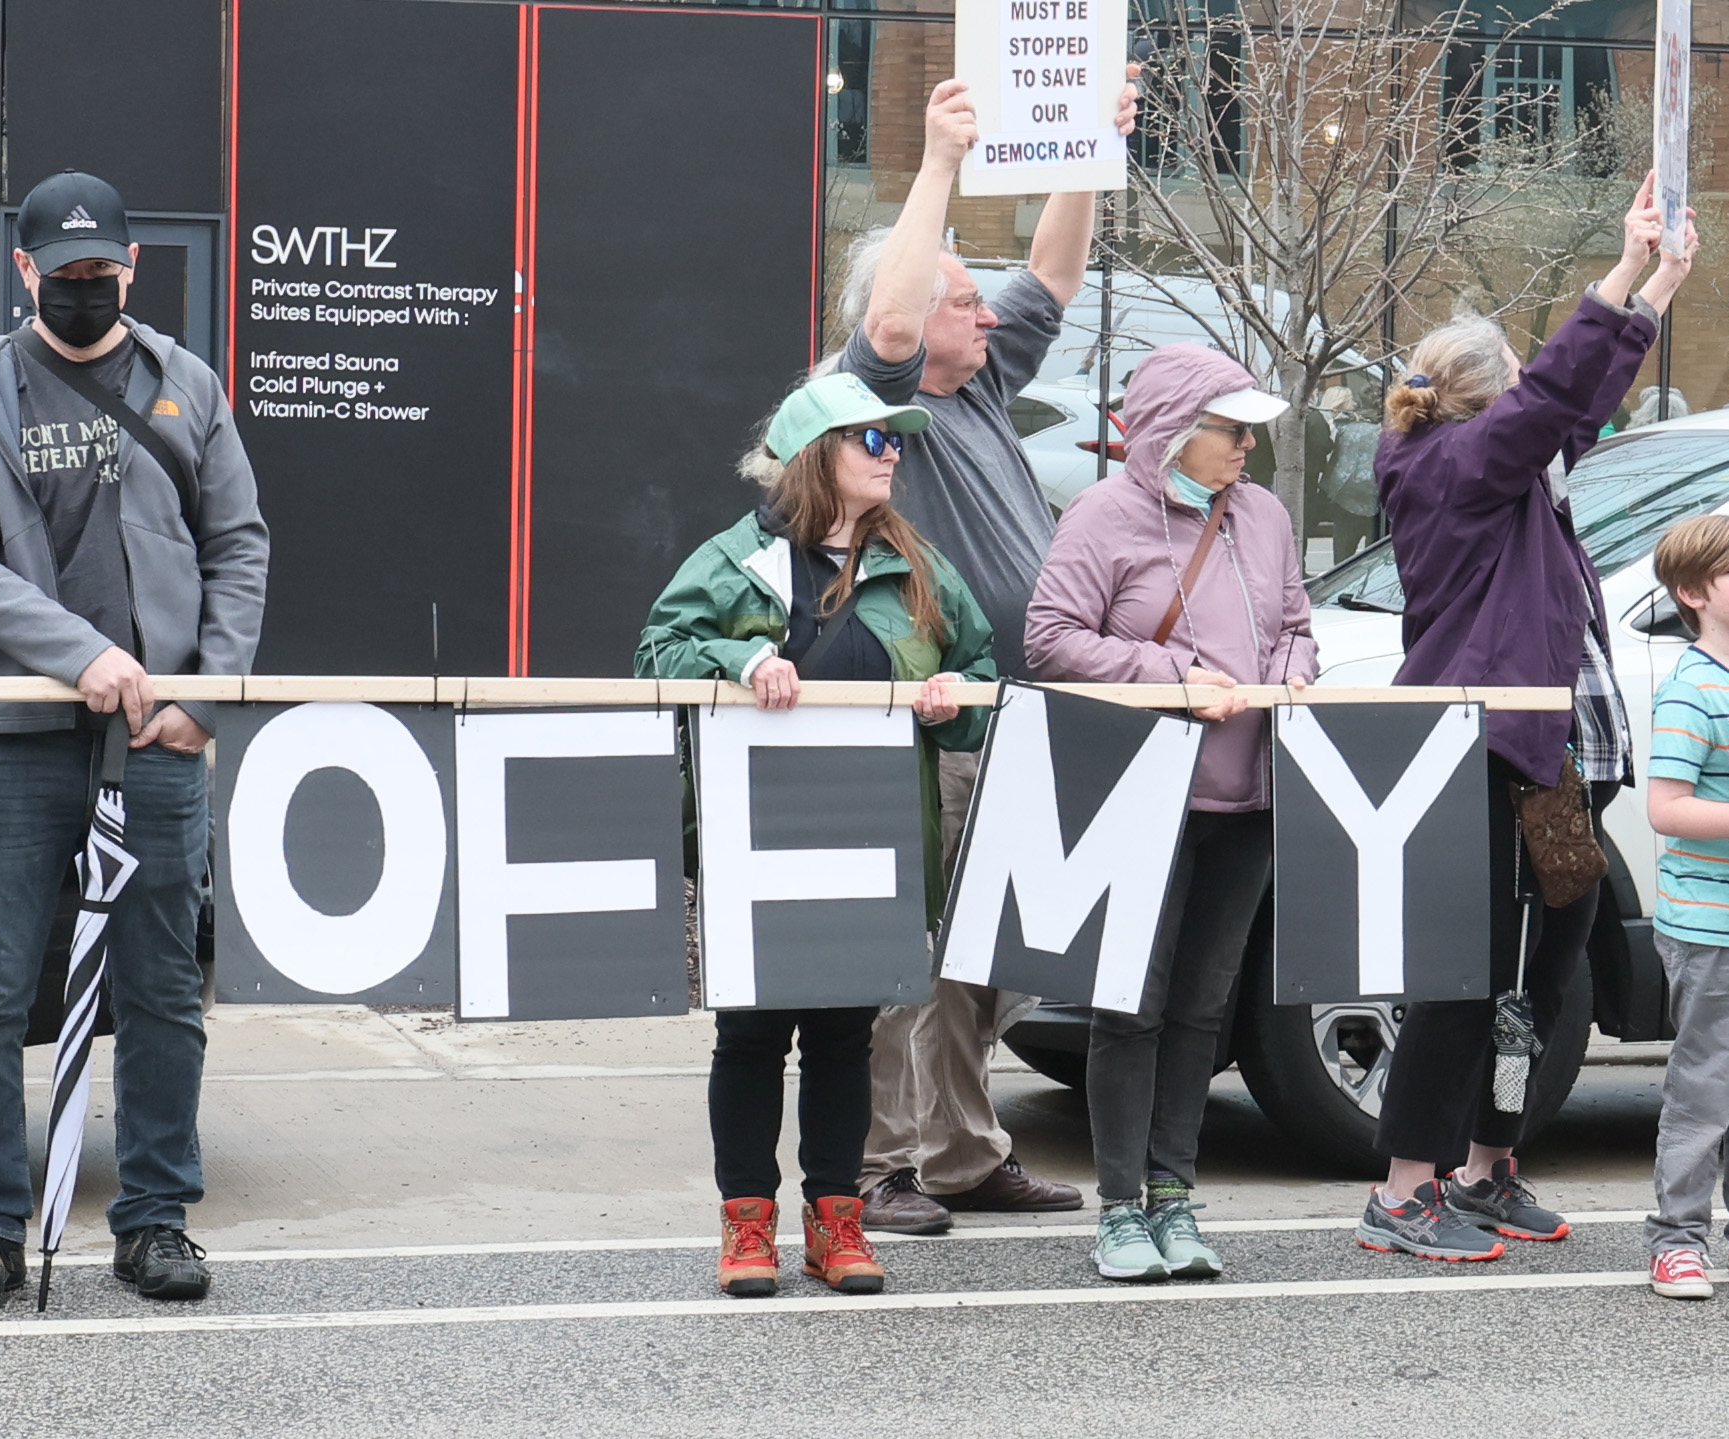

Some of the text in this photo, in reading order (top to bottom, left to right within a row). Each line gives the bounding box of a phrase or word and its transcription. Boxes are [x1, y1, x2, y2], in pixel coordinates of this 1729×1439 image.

[1011, 1, 1088, 20] MUST BE
[1009, 37, 1088, 56] STOPPED
[1012, 68, 1087, 88] TO SAVE
[1032, 104, 1068, 123] OUR
[61, 219, 98, 230] adidas
[251, 224, 397, 268] SWTHZ
[251, 279, 498, 306] Private Contrast Therapy
[251, 303, 311, 322] Suites
[315, 305, 410, 327] Equipped
[414, 307, 460, 325] With
[251, 351, 399, 372] Infrared Sauna
[250, 376, 297, 394] Cold
[302, 377, 370, 398] Plunge
[249, 400, 430, 421] Vitamin-C Shower
[228, 702, 914, 1018] OFF
[940, 685, 1479, 1014] MY
